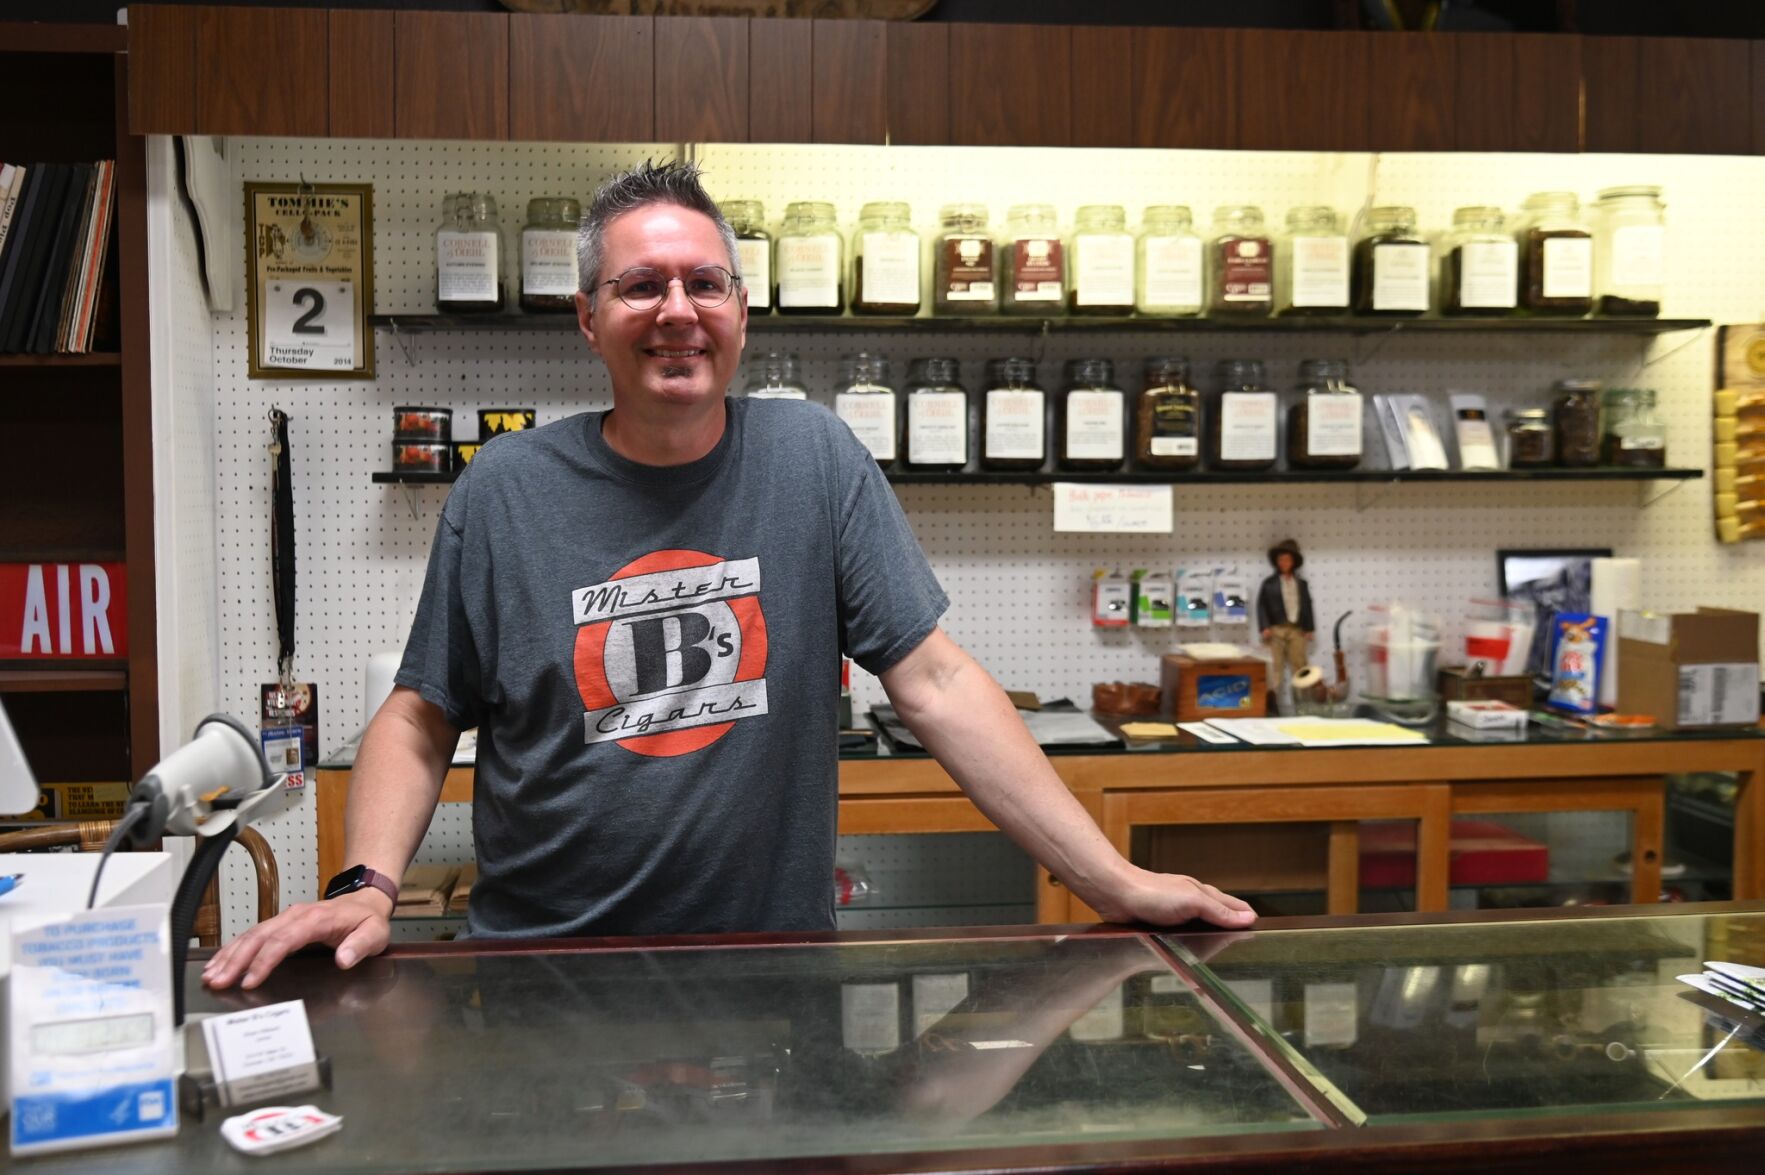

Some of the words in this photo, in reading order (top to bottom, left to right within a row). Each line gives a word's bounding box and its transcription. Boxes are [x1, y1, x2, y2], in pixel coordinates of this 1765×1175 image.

[267, 196, 349, 208] TOMMIE'S
[292, 288, 325, 334] 2
[269, 356, 308, 365] October
[270, 346, 314, 357] Thursday
[582, 577, 753, 615] Mister
[21, 564, 114, 655] AIR
[621, 613, 734, 697] B's
[596, 696, 757, 733] Cigars
[43, 925, 60, 937] TO
[64, 919, 136, 934] PURCHASE
[22, 939, 84, 954] TOBACCO
[87, 931, 159, 947] PRODUCTS
[67, 953, 102, 964] MUST
[109, 949, 144, 960] HAVE
[95, 966, 131, 979] BORN
